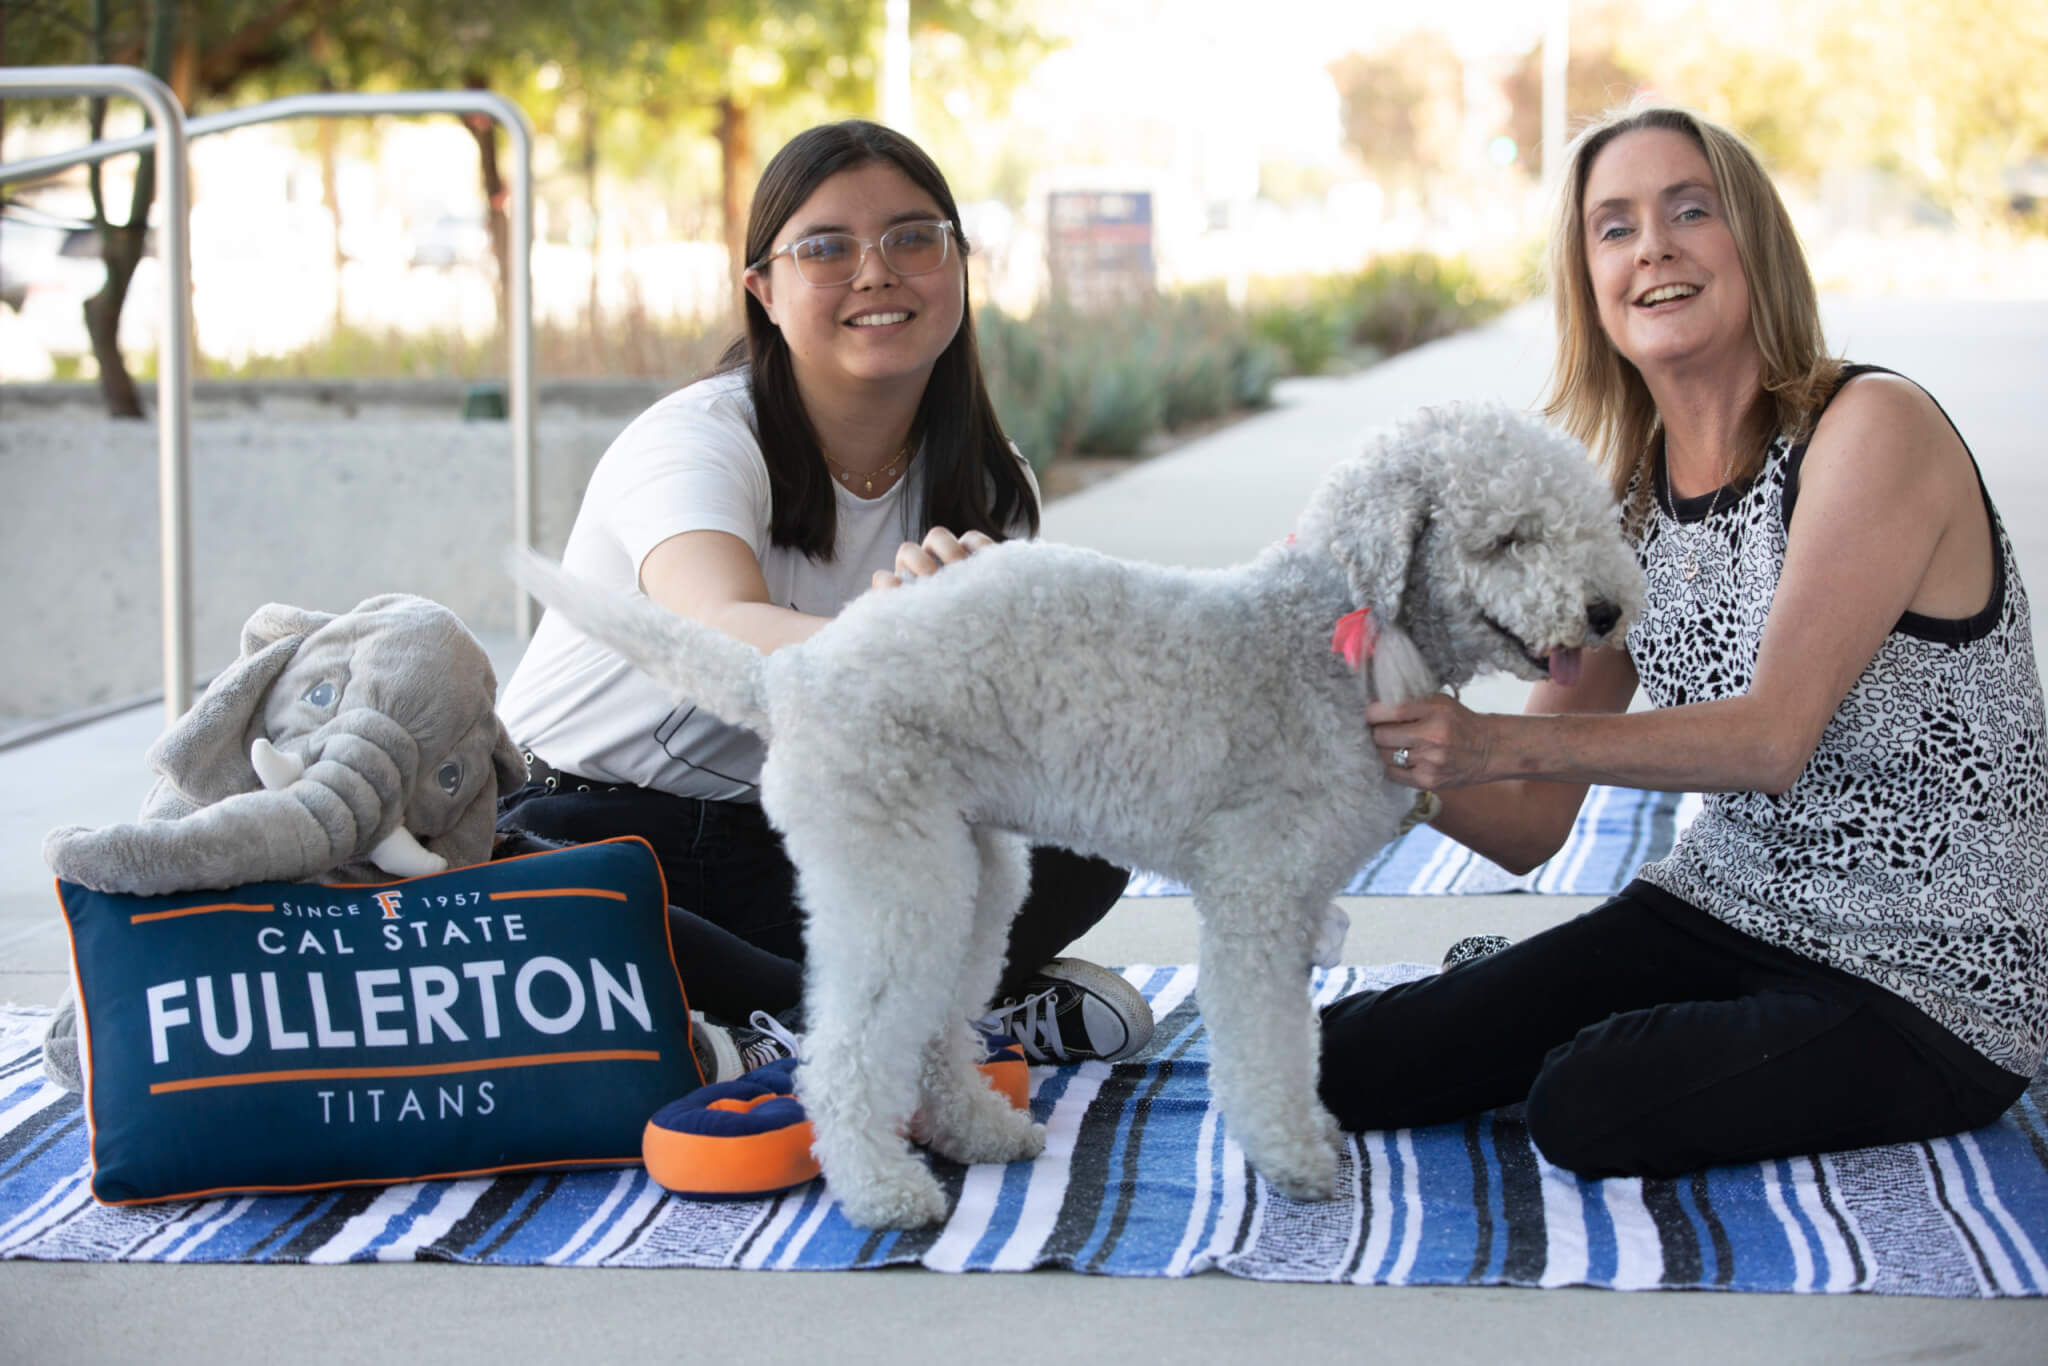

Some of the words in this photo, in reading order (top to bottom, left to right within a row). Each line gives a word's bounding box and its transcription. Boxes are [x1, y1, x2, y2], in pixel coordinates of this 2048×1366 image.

[282, 902, 361, 918] SINCE
[421, 892, 481, 909] 1957
[257, 927, 354, 955] CAL
[382, 914, 527, 951] STATE
[146, 956, 653, 1065] FULLERTON
[318, 1081, 496, 1125] TITANS
